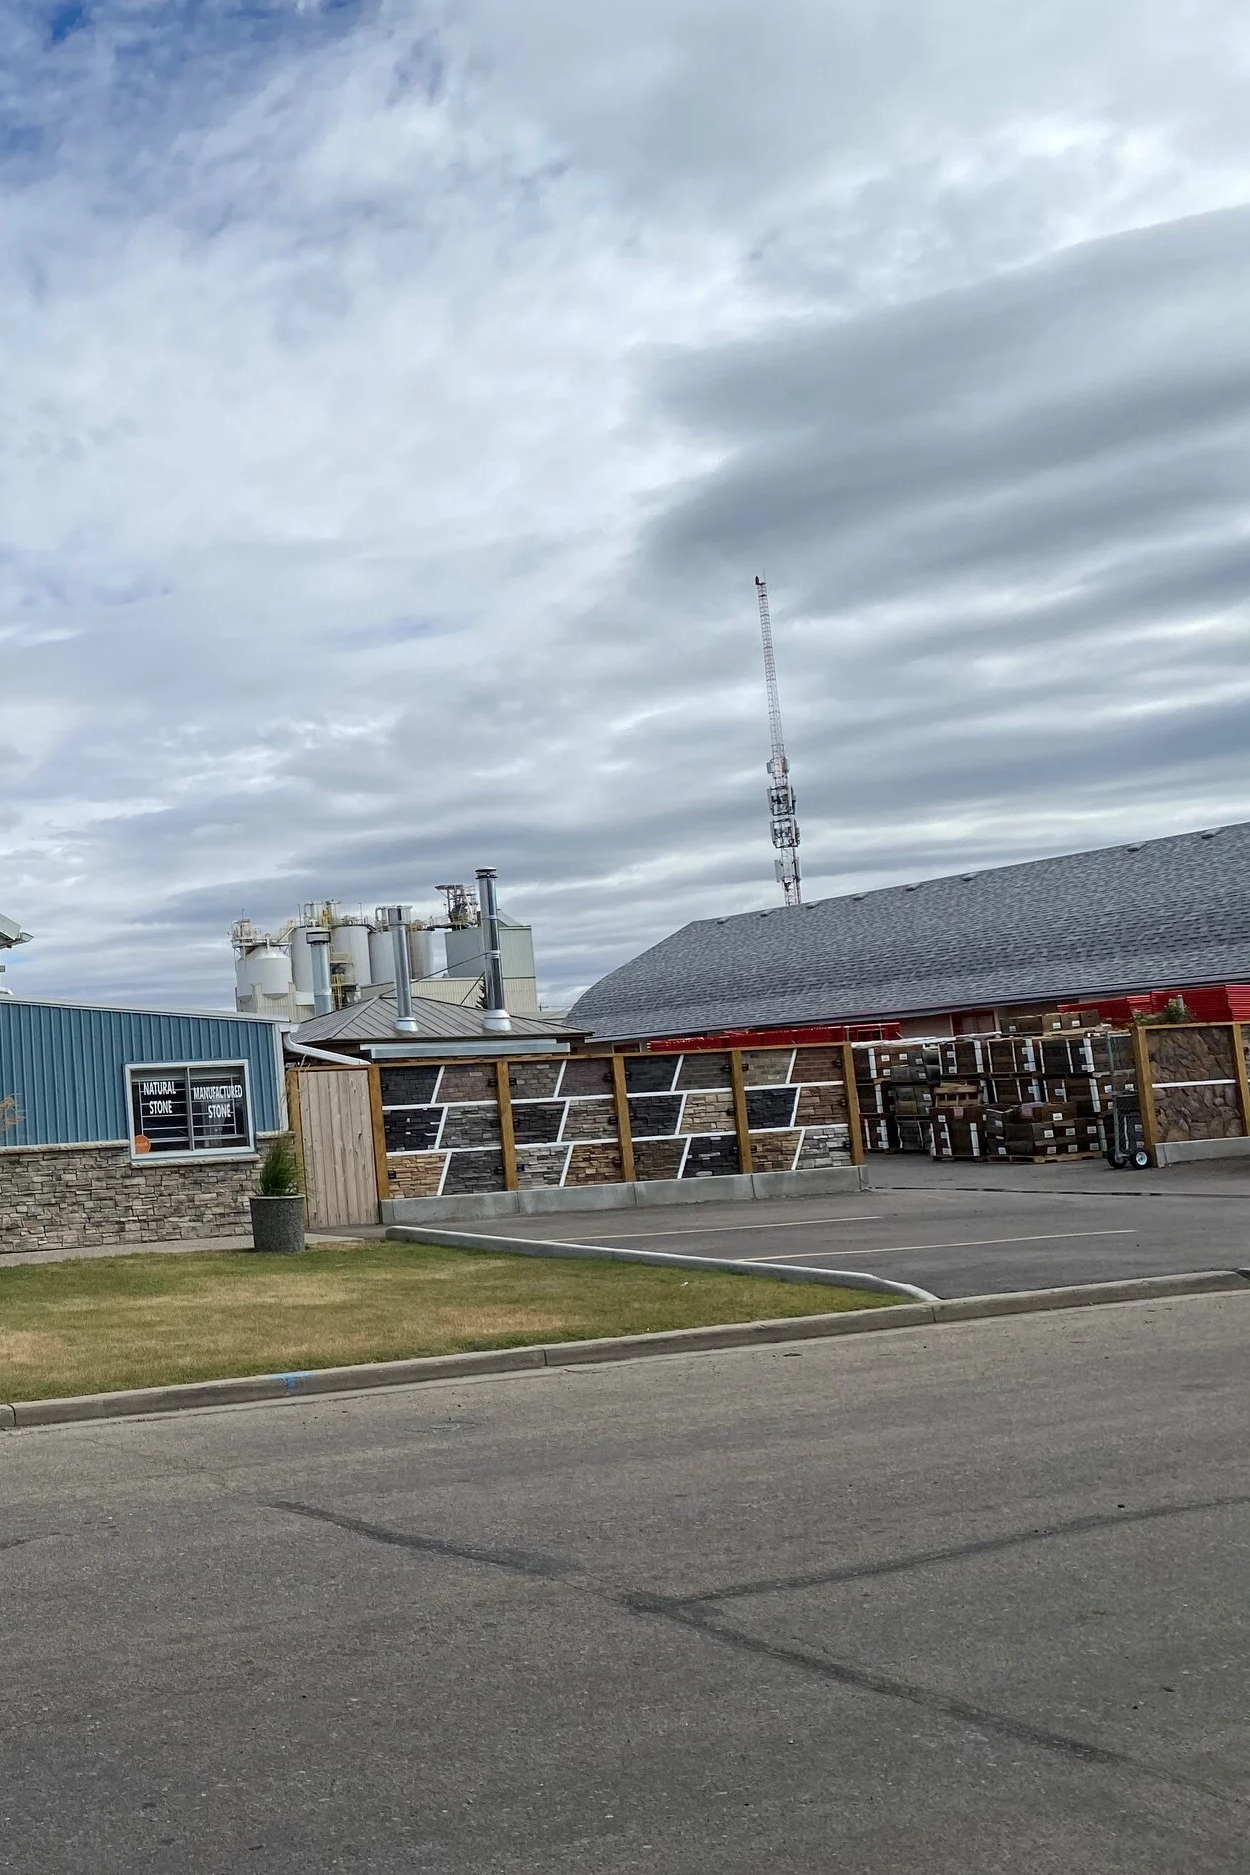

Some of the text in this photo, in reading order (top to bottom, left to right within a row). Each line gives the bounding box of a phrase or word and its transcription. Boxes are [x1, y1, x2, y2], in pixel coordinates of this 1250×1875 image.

[143, 1081, 176, 1095] NATURAL
[193, 1084, 243, 1100] MANUFACTURED
[149, 1100, 173, 1115] STONE
[208, 1104, 232, 1119] STONE
